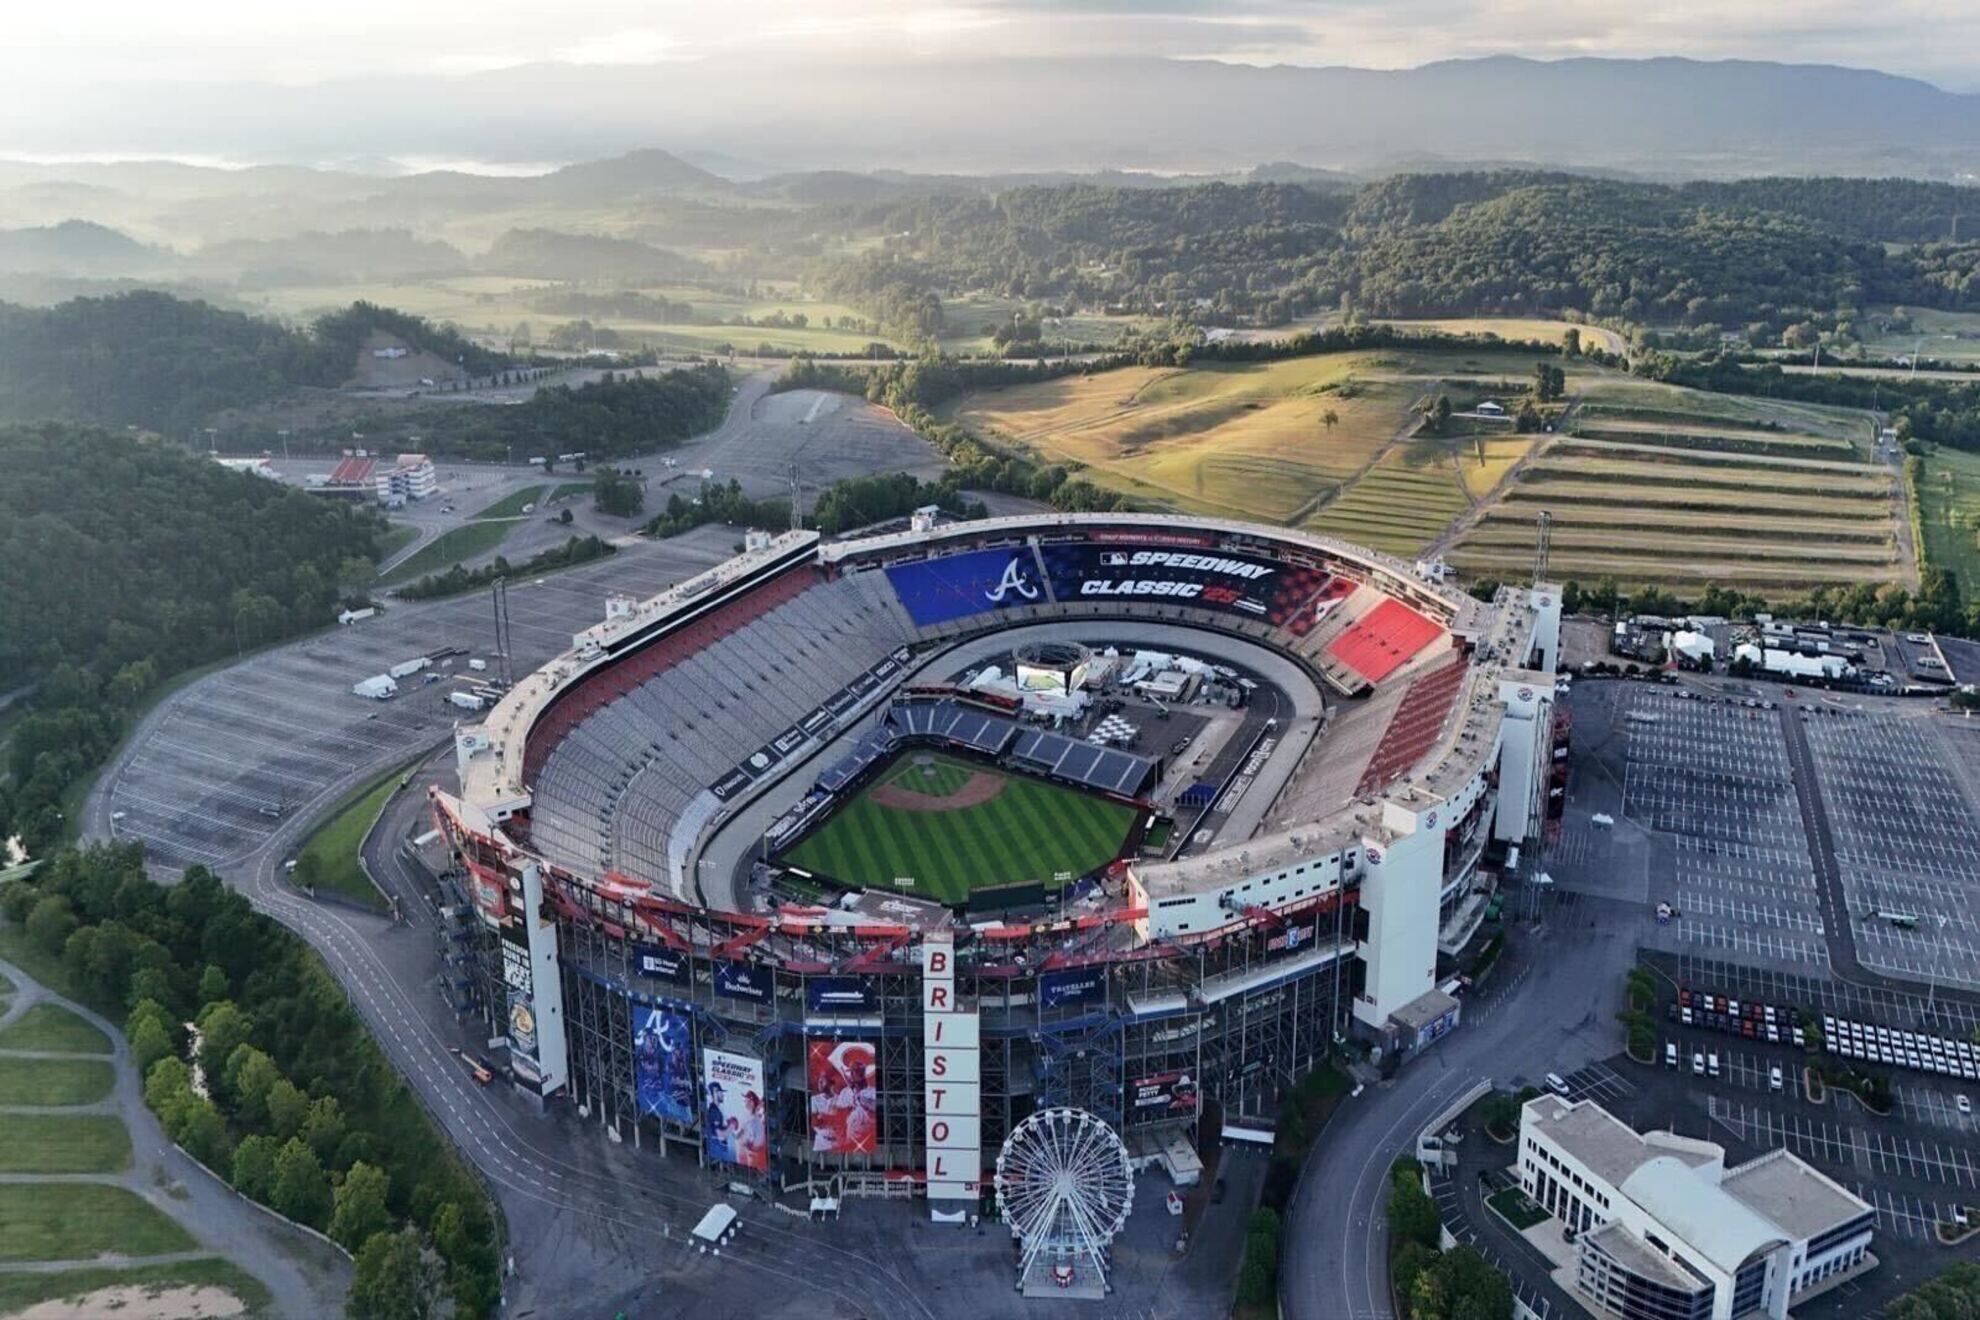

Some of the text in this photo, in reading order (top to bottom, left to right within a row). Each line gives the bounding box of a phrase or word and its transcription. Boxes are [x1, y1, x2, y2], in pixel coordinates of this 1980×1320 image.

[1129, 551, 1275, 580] SPEEDWAY
[1080, 580, 1203, 598] CLASSIC
[724, 981, 763, 997] Budweiser
[711, 1060, 753, 1073] SPEEDWAY
[711, 1066, 745, 1079] CLASSIC
[929, 952, 949, 1176] BRISTOL
